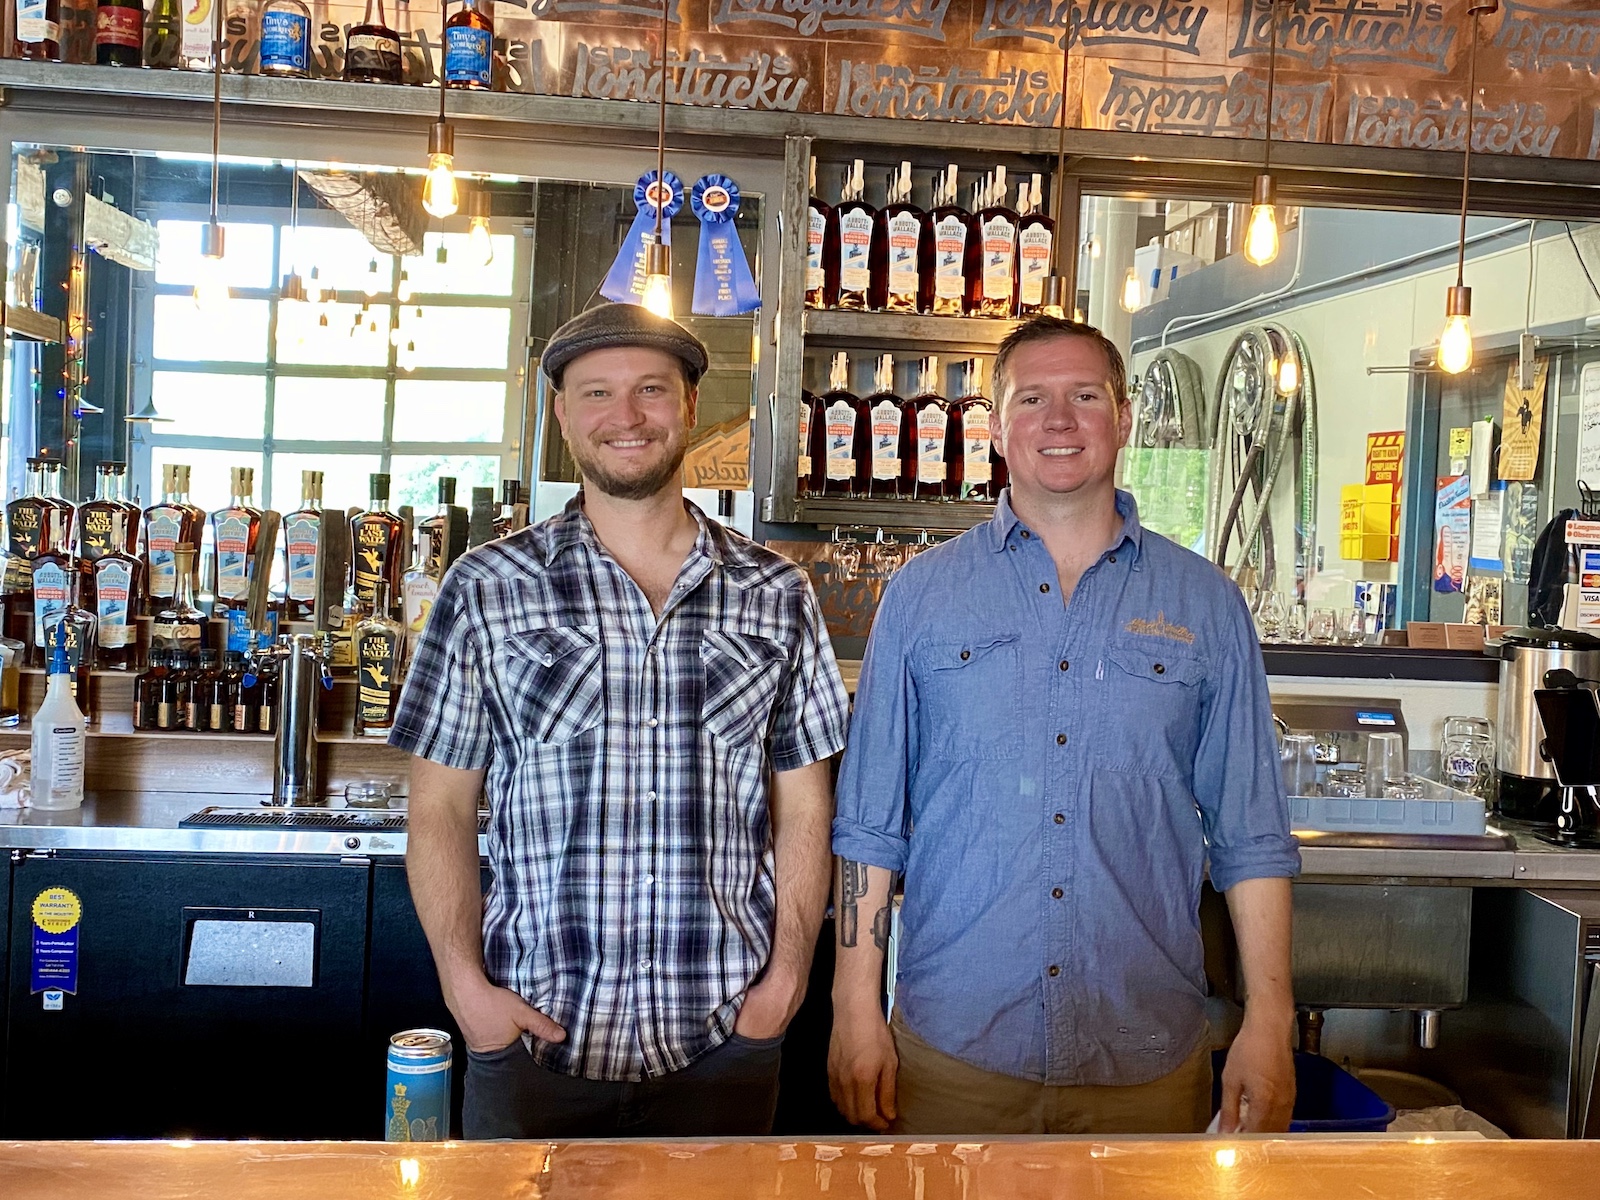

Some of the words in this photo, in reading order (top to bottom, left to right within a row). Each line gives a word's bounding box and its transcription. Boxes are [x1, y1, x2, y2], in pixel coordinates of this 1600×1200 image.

[18, 507, 35, 515] THE
[13, 513, 38, 521] LAST
[86, 517, 111, 525] LAST
[12, 520, 38, 529] WALTZ
[85, 524, 112, 532] WALTZ
[363, 523, 382, 531] THE
[360, 529, 385, 537] LAST
[358, 536, 386, 544] WALTZ
[368, 636, 386, 644] THE
[362, 650, 391, 658] WALTZ
[248, 911, 255, 919] R
